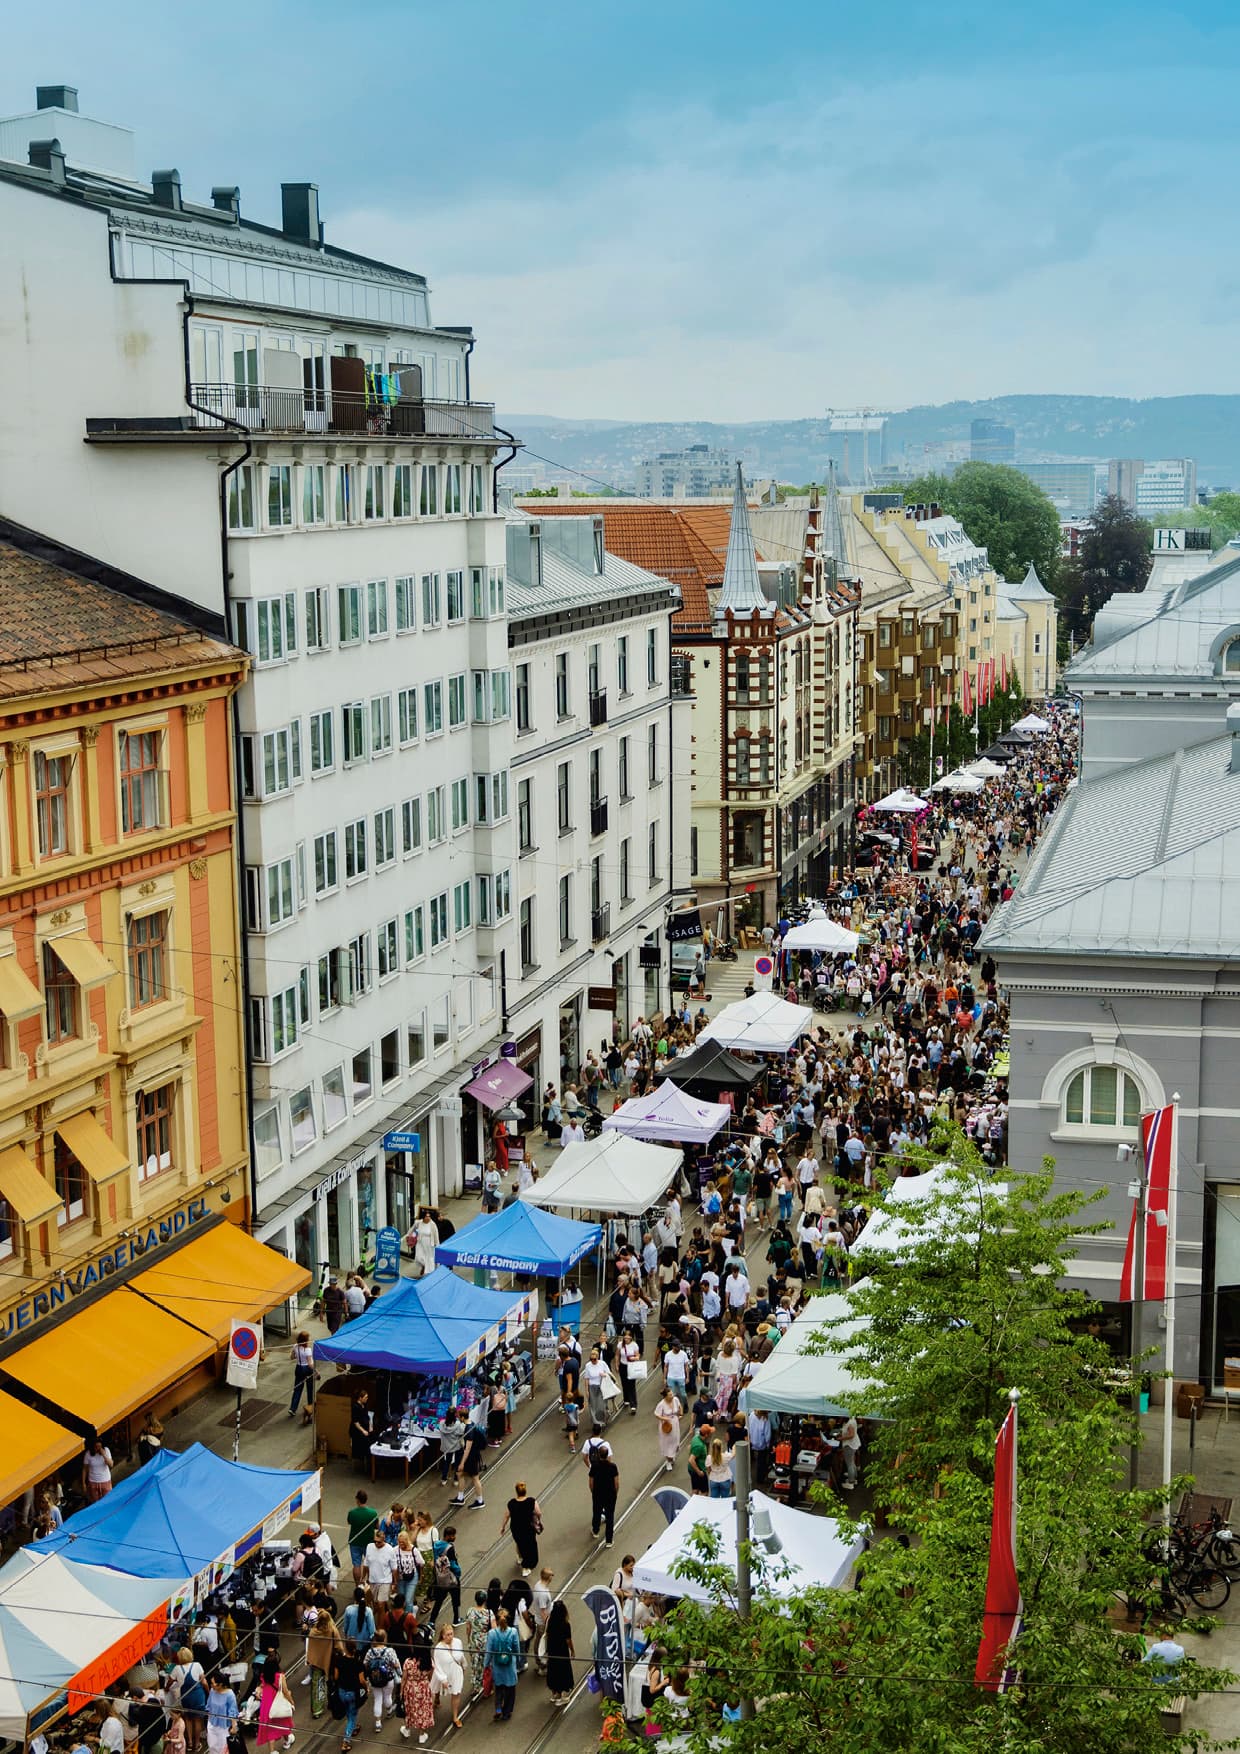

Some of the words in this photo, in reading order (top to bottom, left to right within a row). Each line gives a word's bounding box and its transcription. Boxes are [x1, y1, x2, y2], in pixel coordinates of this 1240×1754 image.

[1158, 530, 1179, 548] HK
[456, 1252, 481, 1265] Kjell
[480, 1254, 488, 1266] &
[489, 1256, 539, 1273] Company
